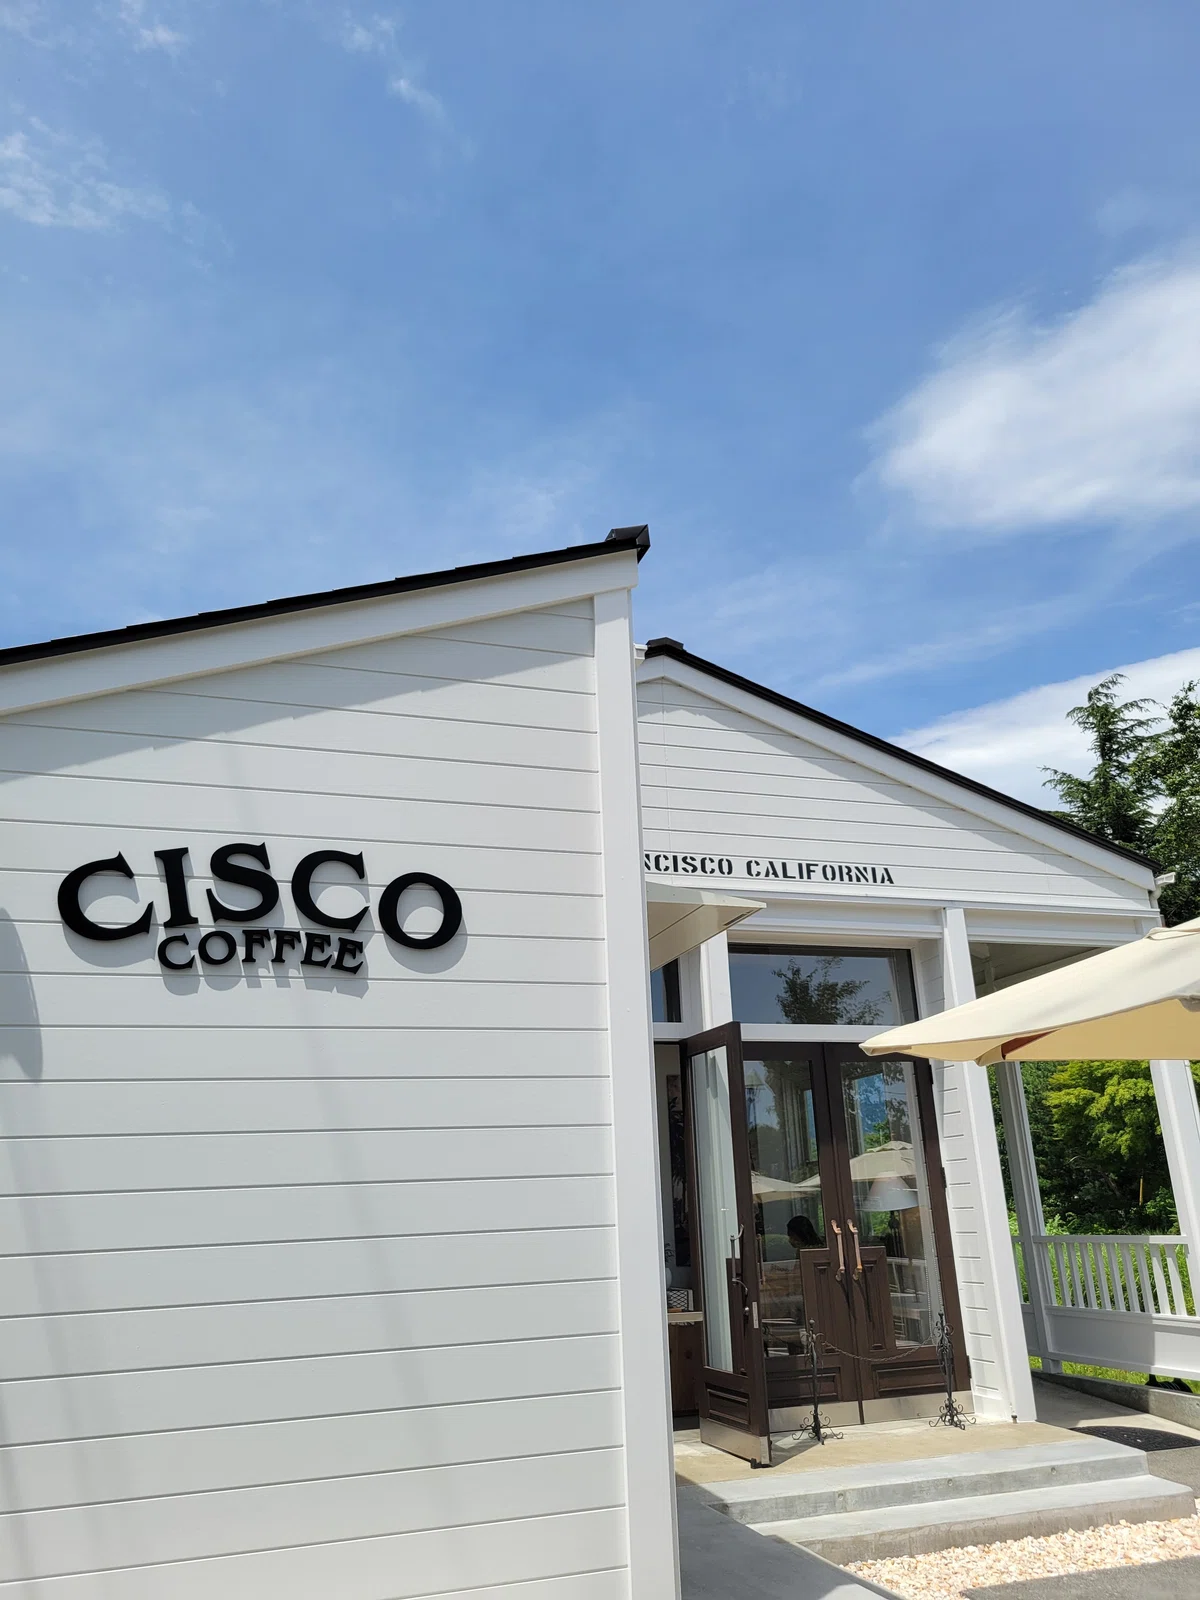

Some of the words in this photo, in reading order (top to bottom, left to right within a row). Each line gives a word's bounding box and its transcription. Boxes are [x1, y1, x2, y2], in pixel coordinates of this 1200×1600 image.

[746, 860, 895, 885] CALIFORNIA
[57, 842, 463, 951] CISCO
[157, 929, 364, 975] COFFEE
